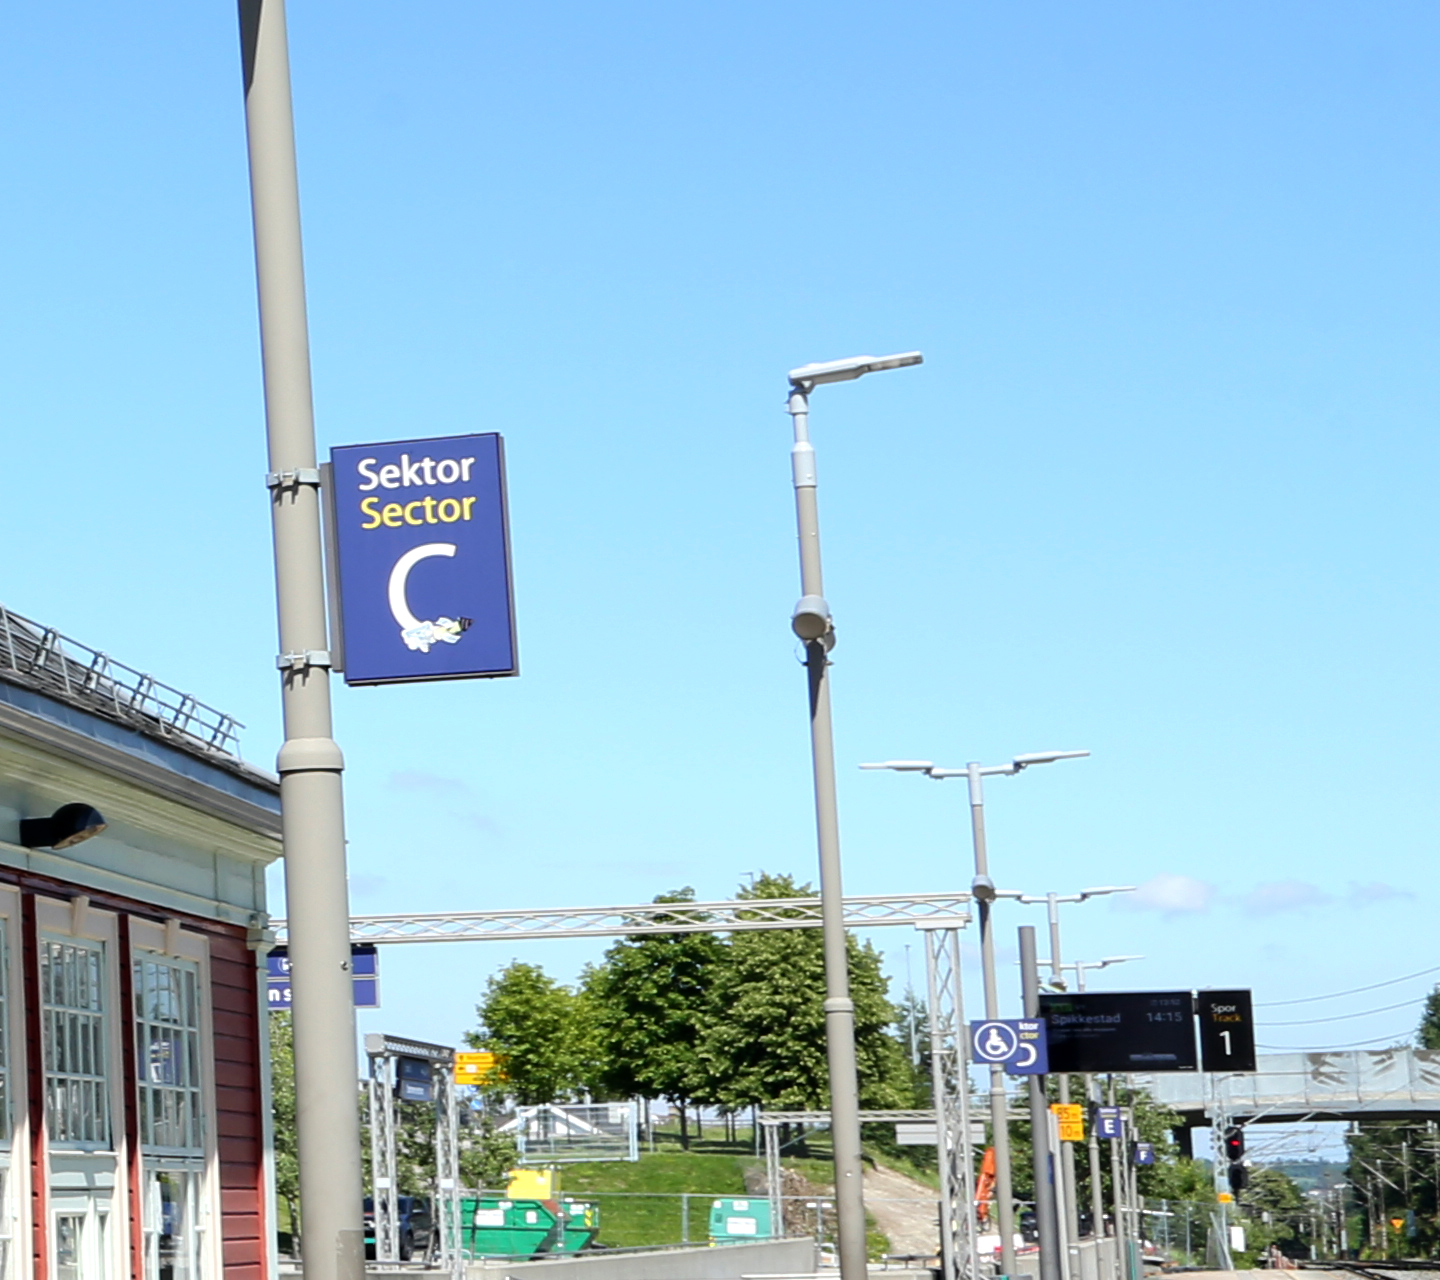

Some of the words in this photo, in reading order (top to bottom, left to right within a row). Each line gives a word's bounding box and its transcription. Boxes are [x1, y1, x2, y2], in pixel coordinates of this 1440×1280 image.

[357, 454, 476, 491] Sektor
[360, 495, 477, 529] Sector
[388, 542, 457, 644] C
[1210, 1003, 1237, 1014] Spor
[1051, 1013, 1121, 1026] Spikkestad
[1146, 1012, 1183, 1022] 14:15
[1213, 1013, 1242, 1023] Track
[1018, 1022, 1039, 1031] ktor
[1219, 1030, 1232, 1056] 1
[1104, 1119, 1116, 1134] E
[1140, 1151, 1148, 1161] F
